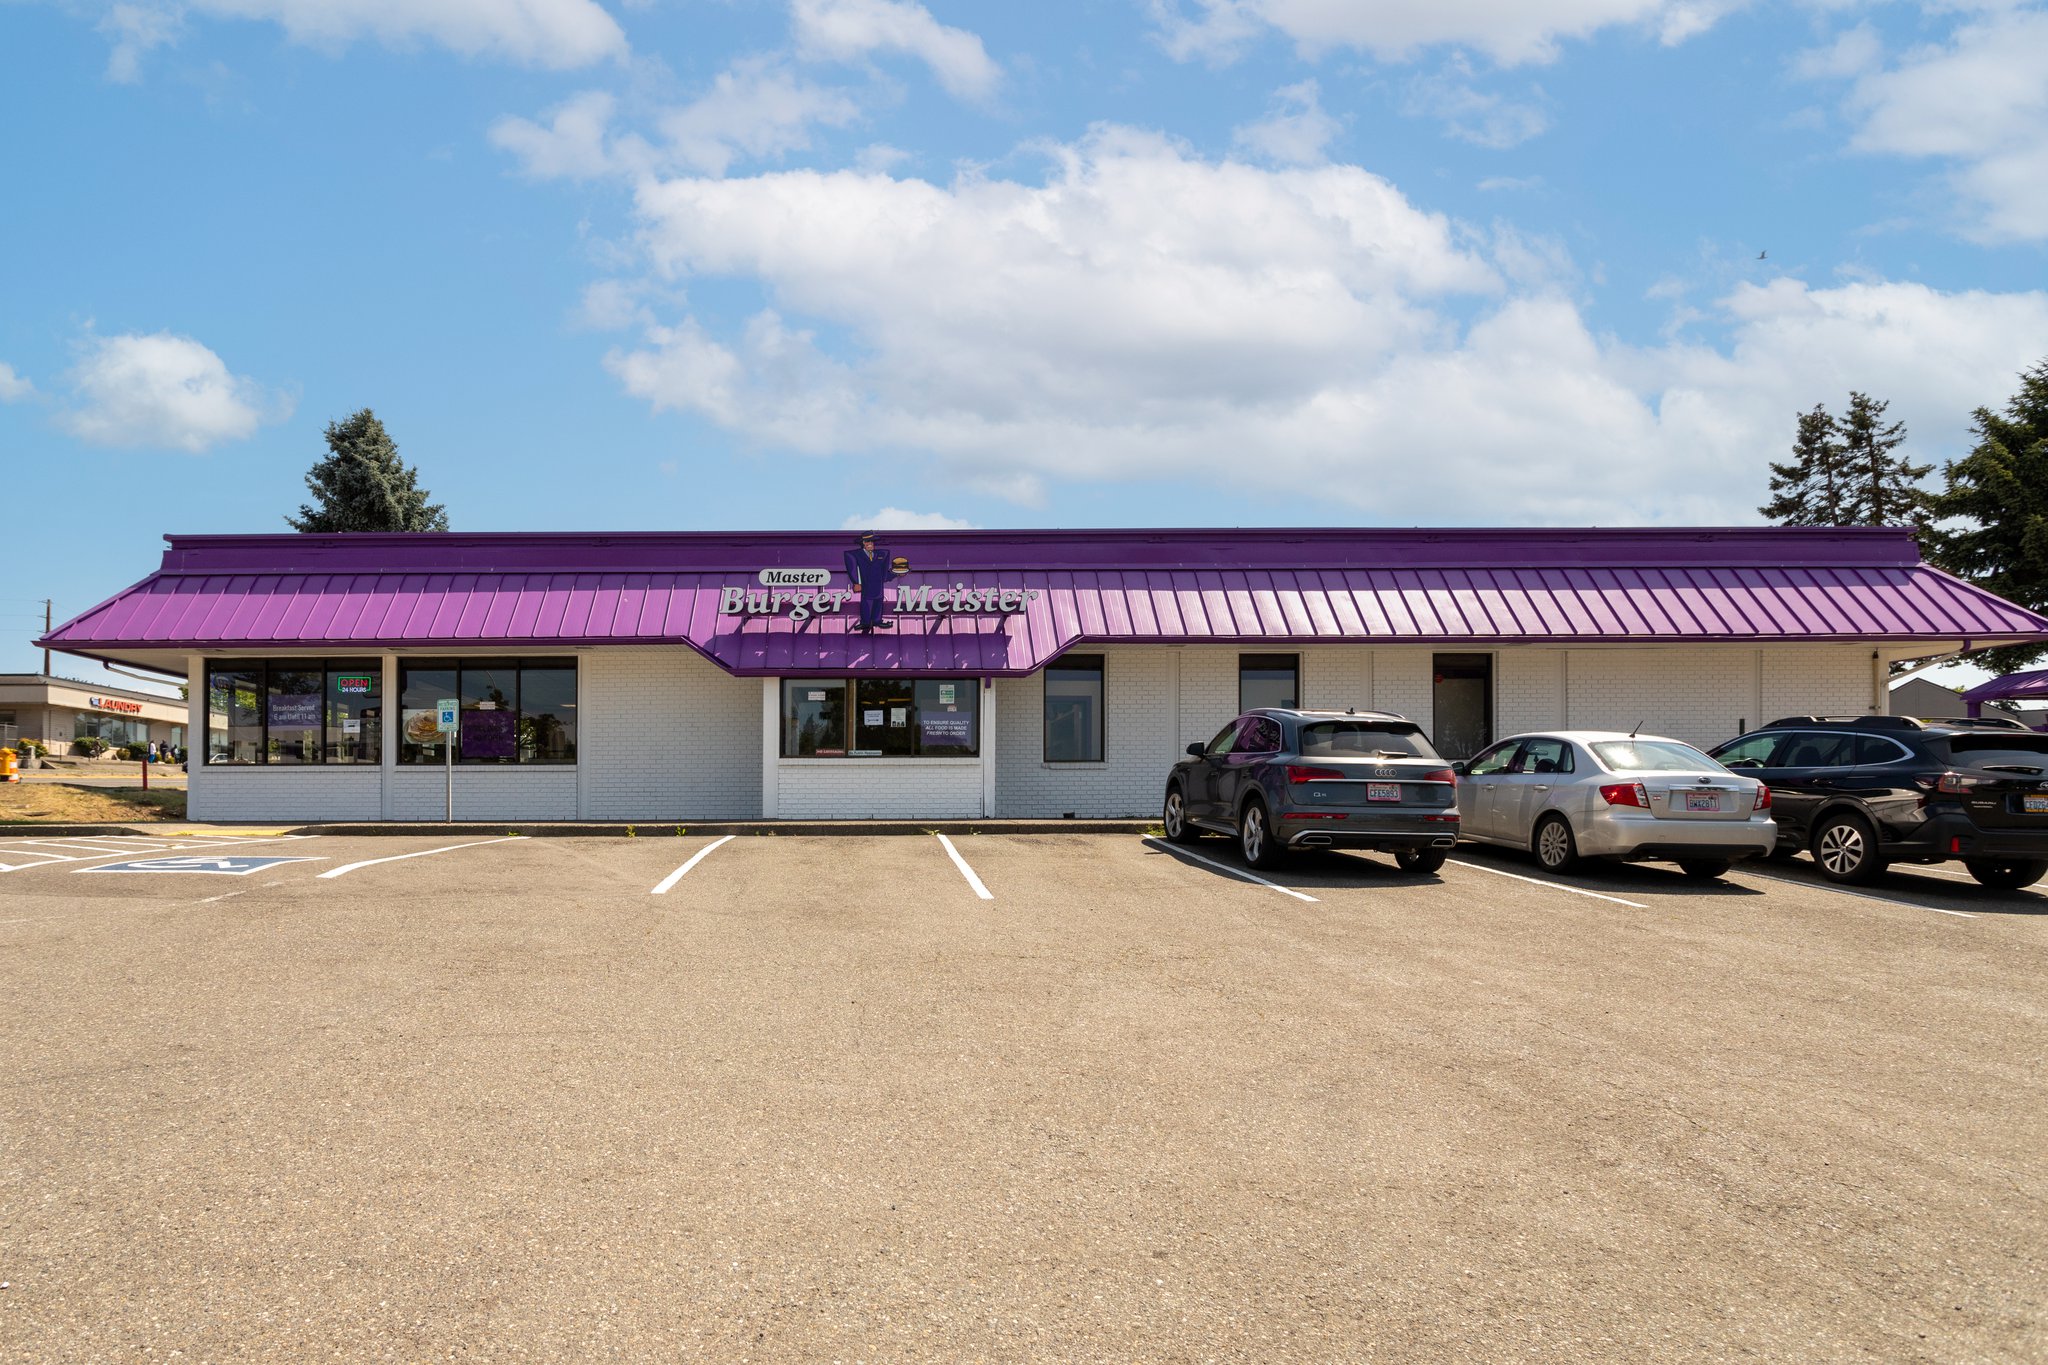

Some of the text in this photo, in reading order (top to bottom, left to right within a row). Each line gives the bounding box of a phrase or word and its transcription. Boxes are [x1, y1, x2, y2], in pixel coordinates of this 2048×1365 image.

[766, 570, 824, 584] Master
[719, 582, 1040, 622] Burger Meister
[340, 679, 369, 687] OPEN
[98, 698, 143, 713] LAUNDRY
